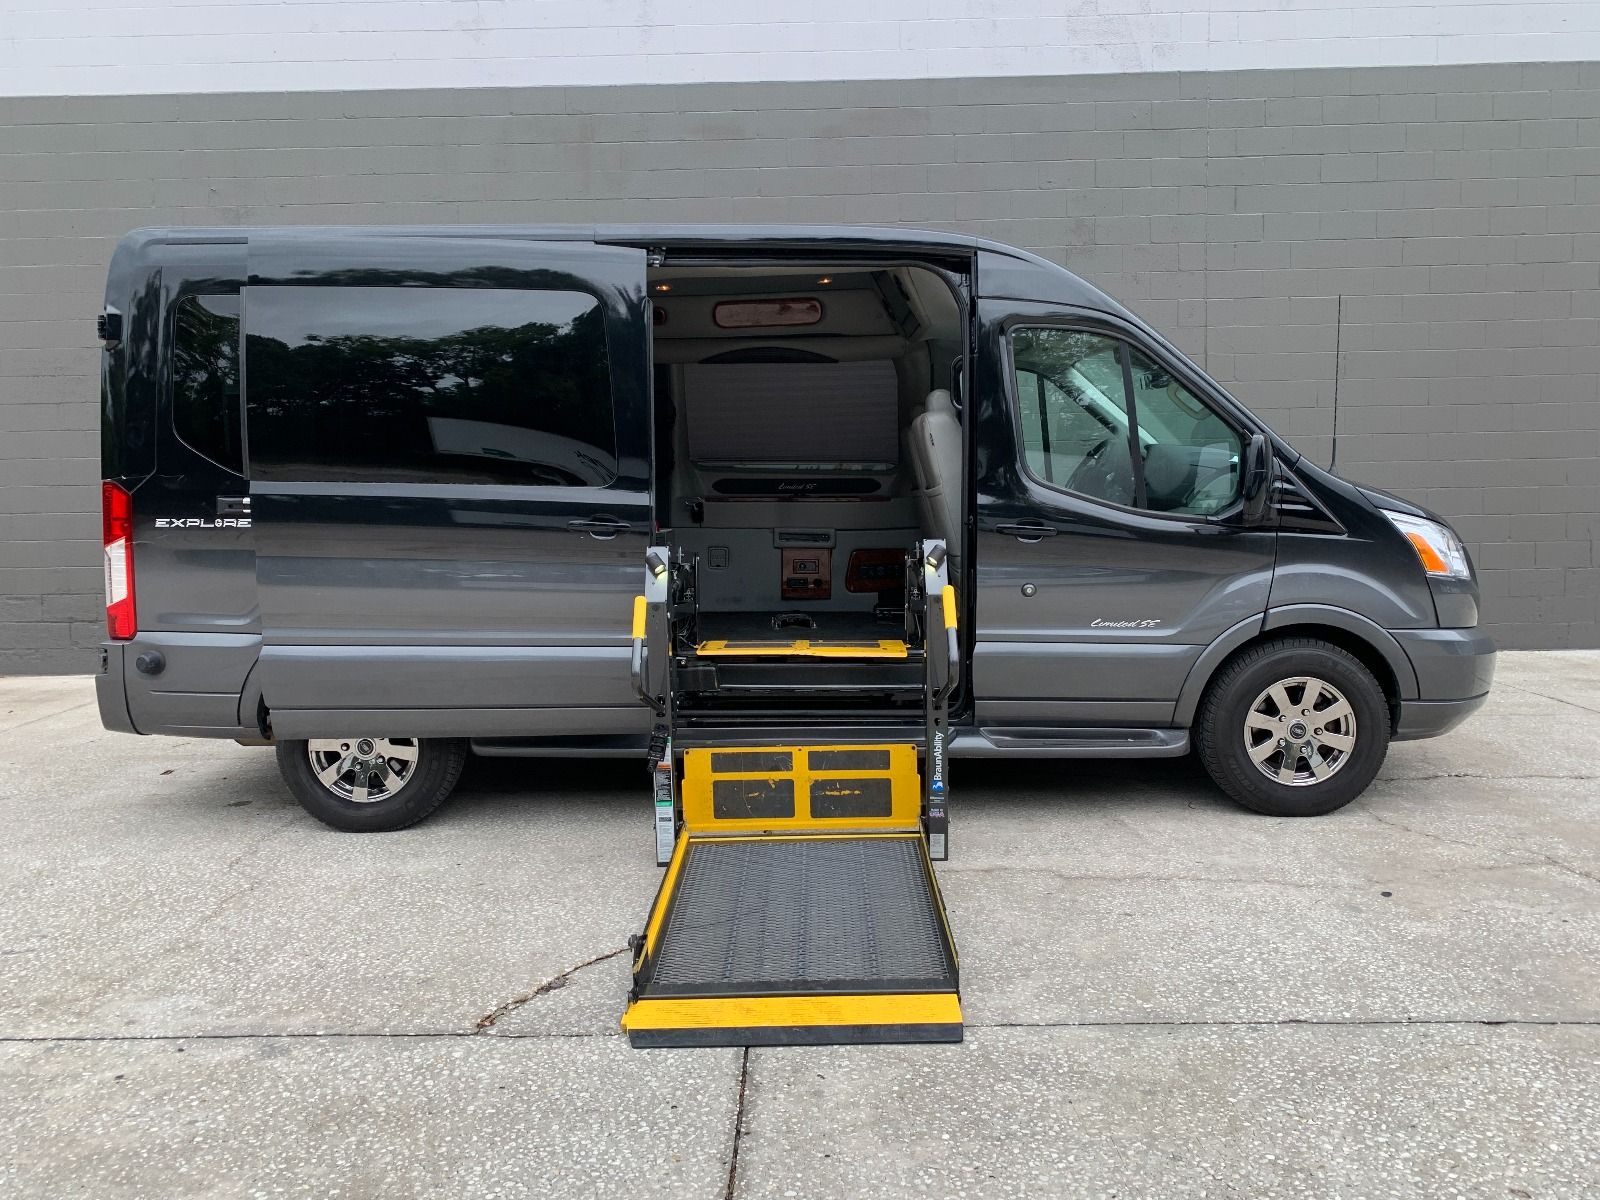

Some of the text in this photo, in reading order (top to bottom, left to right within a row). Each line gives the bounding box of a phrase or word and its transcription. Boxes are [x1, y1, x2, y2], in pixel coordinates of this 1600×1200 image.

[778, 482, 805, 490] Limited
[1090, 618, 1161, 628] Limited SE
[933, 730, 945, 781] BraunAbility
